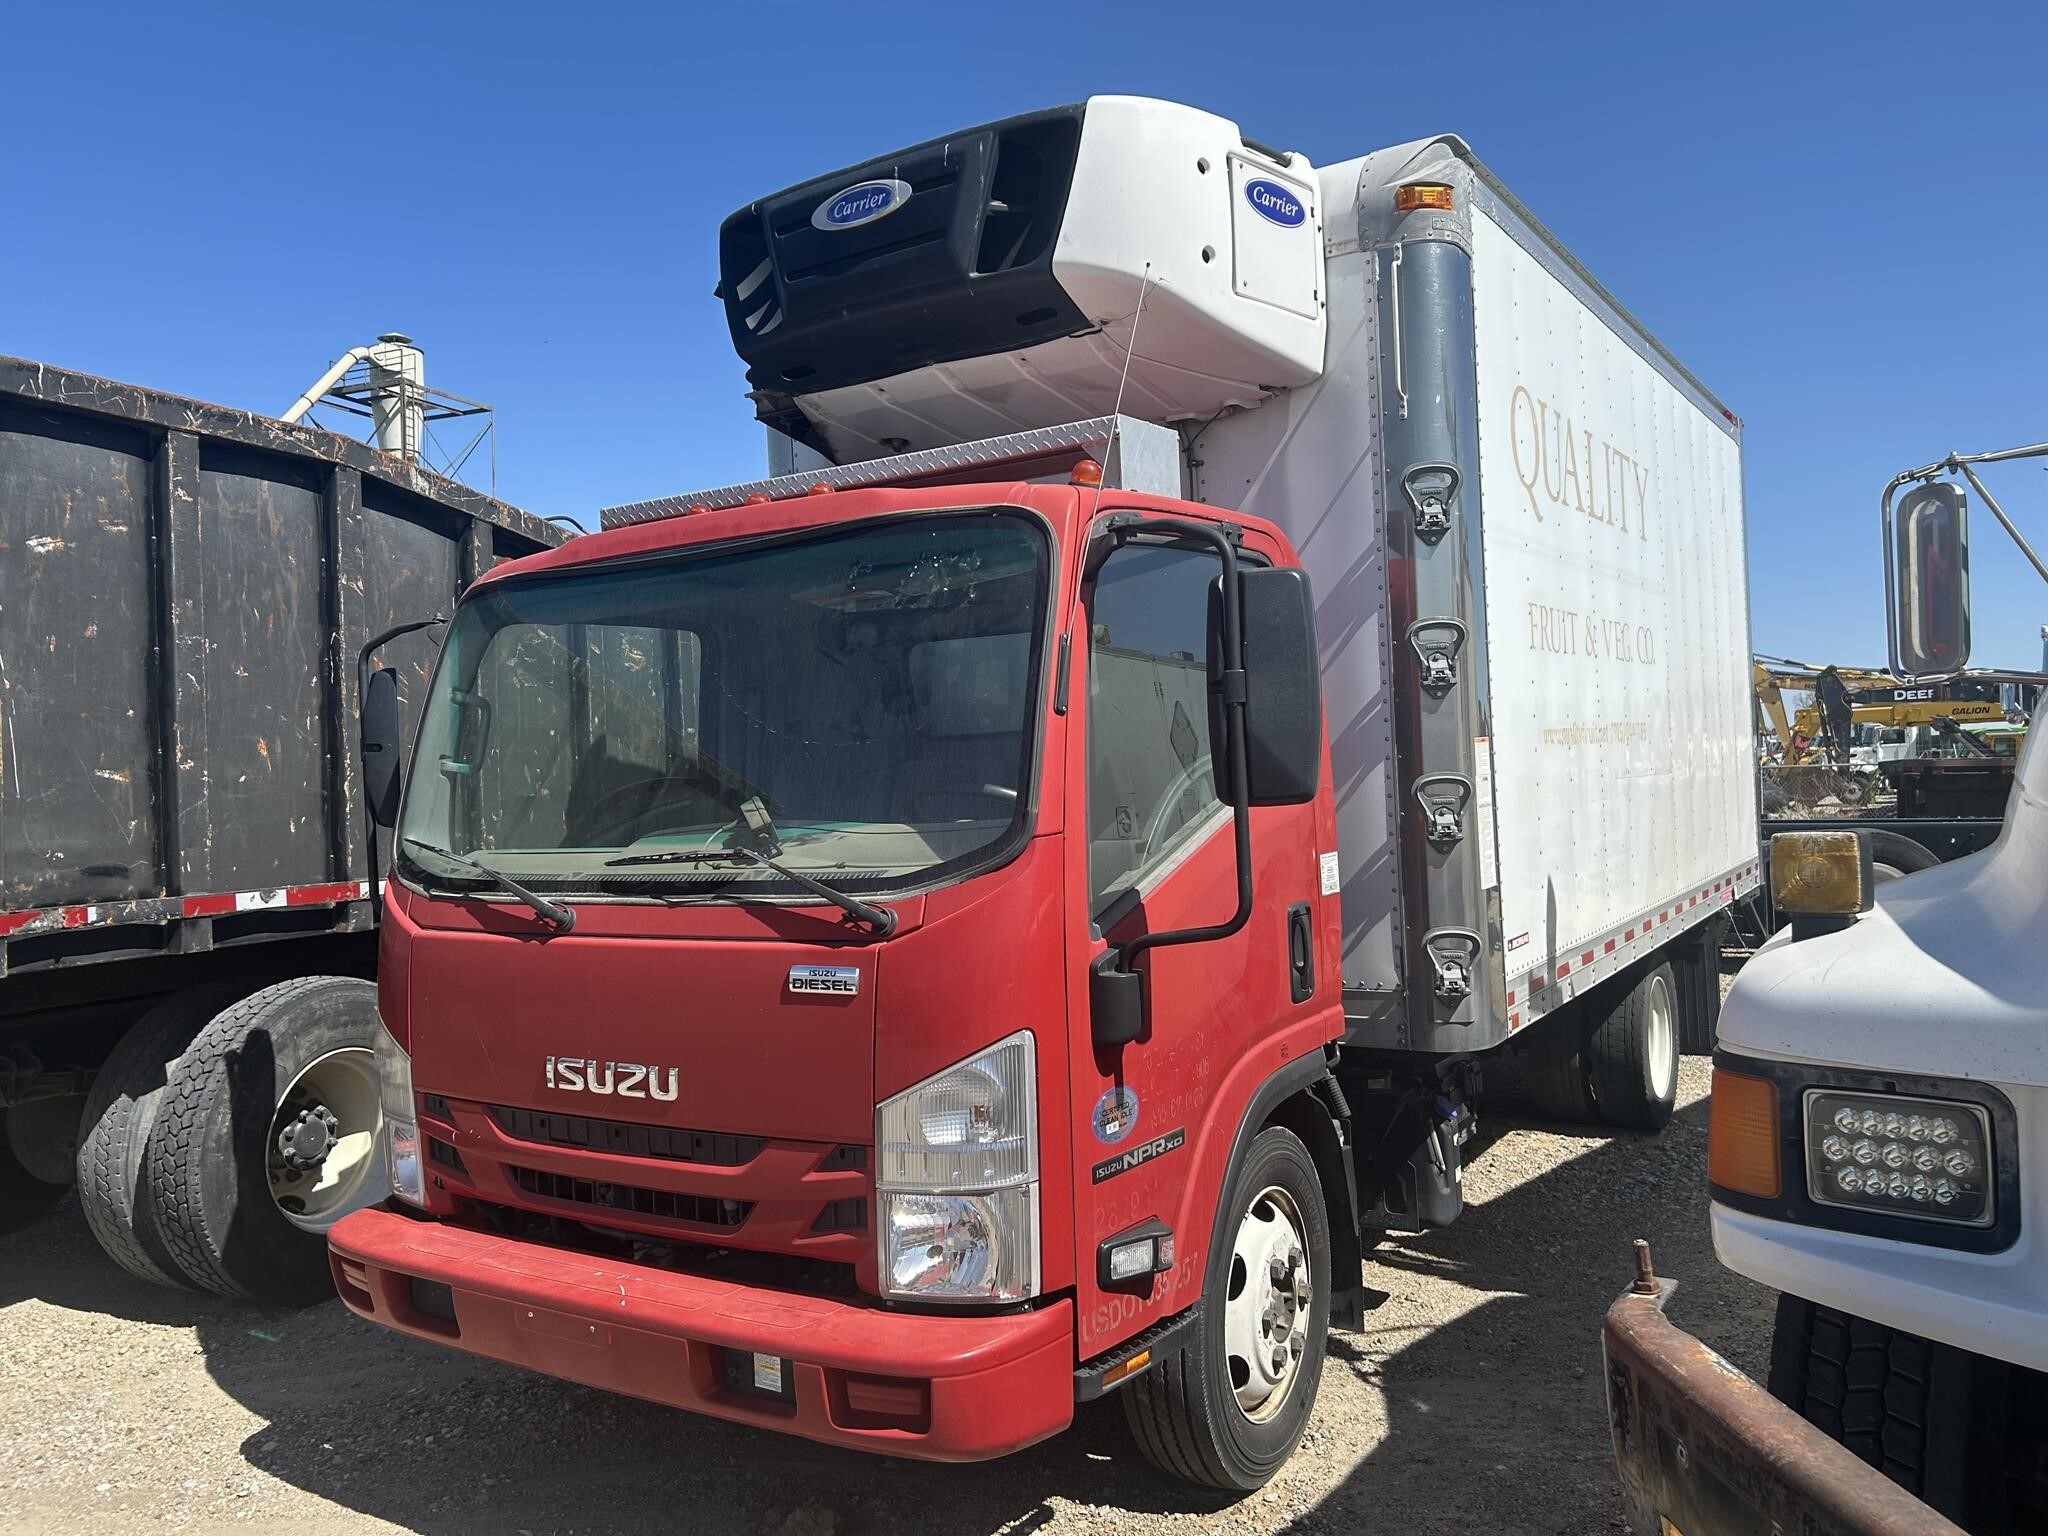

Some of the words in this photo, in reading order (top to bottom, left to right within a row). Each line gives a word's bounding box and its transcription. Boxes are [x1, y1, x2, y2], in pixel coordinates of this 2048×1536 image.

[834, 192, 886, 218] Carrier
[1253, 186, 1298, 216] Carrier
[1510, 385, 1650, 542] QUALITY
[1528, 602, 1578, 655] FRUIT
[1585, 615, 1598, 658] &
[1951, 706, 1991, 715] GALION
[809, 969, 837, 977] ISUZU
[792, 978, 857, 992] DIESEL
[546, 1055, 679, 1102] ISUZU
[1099, 1113, 1120, 1127] CLEAN
[1120, 1108, 1133, 1120] IDLE
[1101, 1101, 1130, 1117] CERTIFIED
[1096, 1161, 1123, 1179] ISUZU
